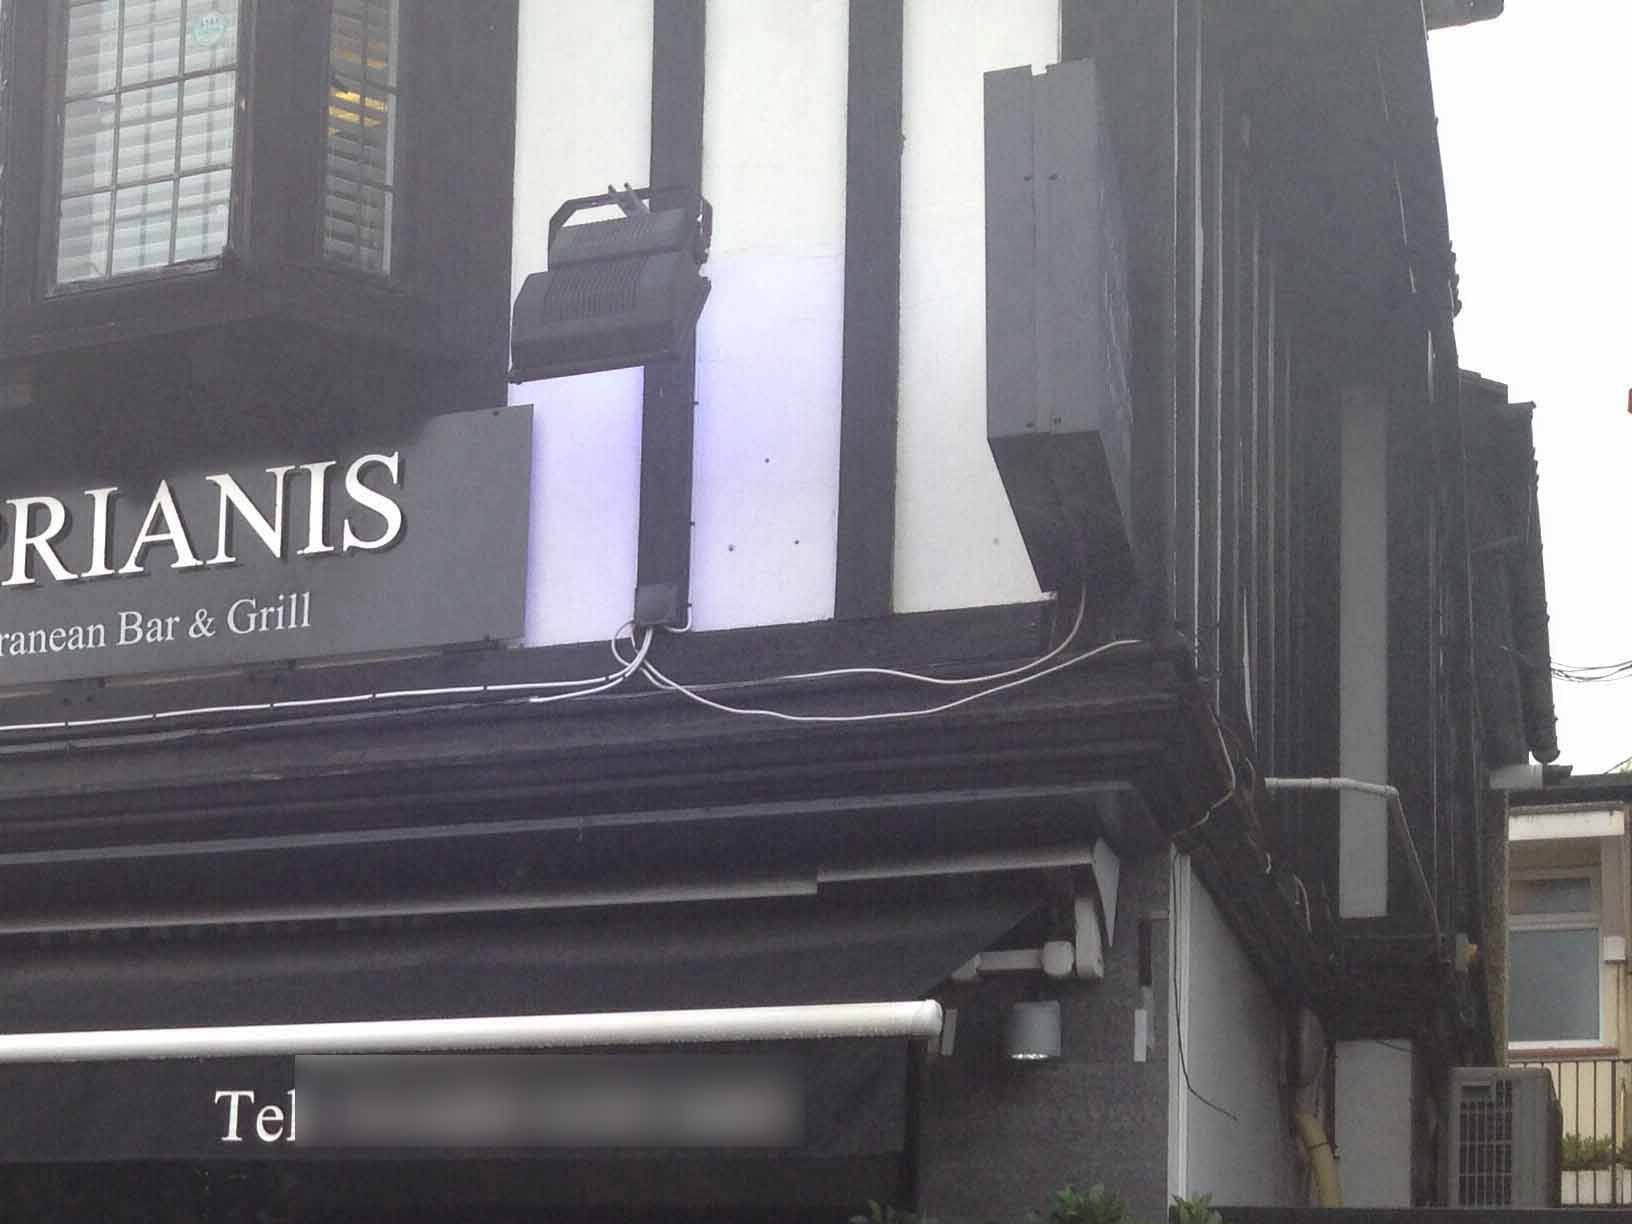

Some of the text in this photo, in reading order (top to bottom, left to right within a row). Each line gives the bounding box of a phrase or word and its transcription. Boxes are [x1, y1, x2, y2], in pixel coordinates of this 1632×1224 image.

[116, 610, 181, 647] Bar
[188, 607, 216, 639] &
[226, 590, 312, 635] Grill
